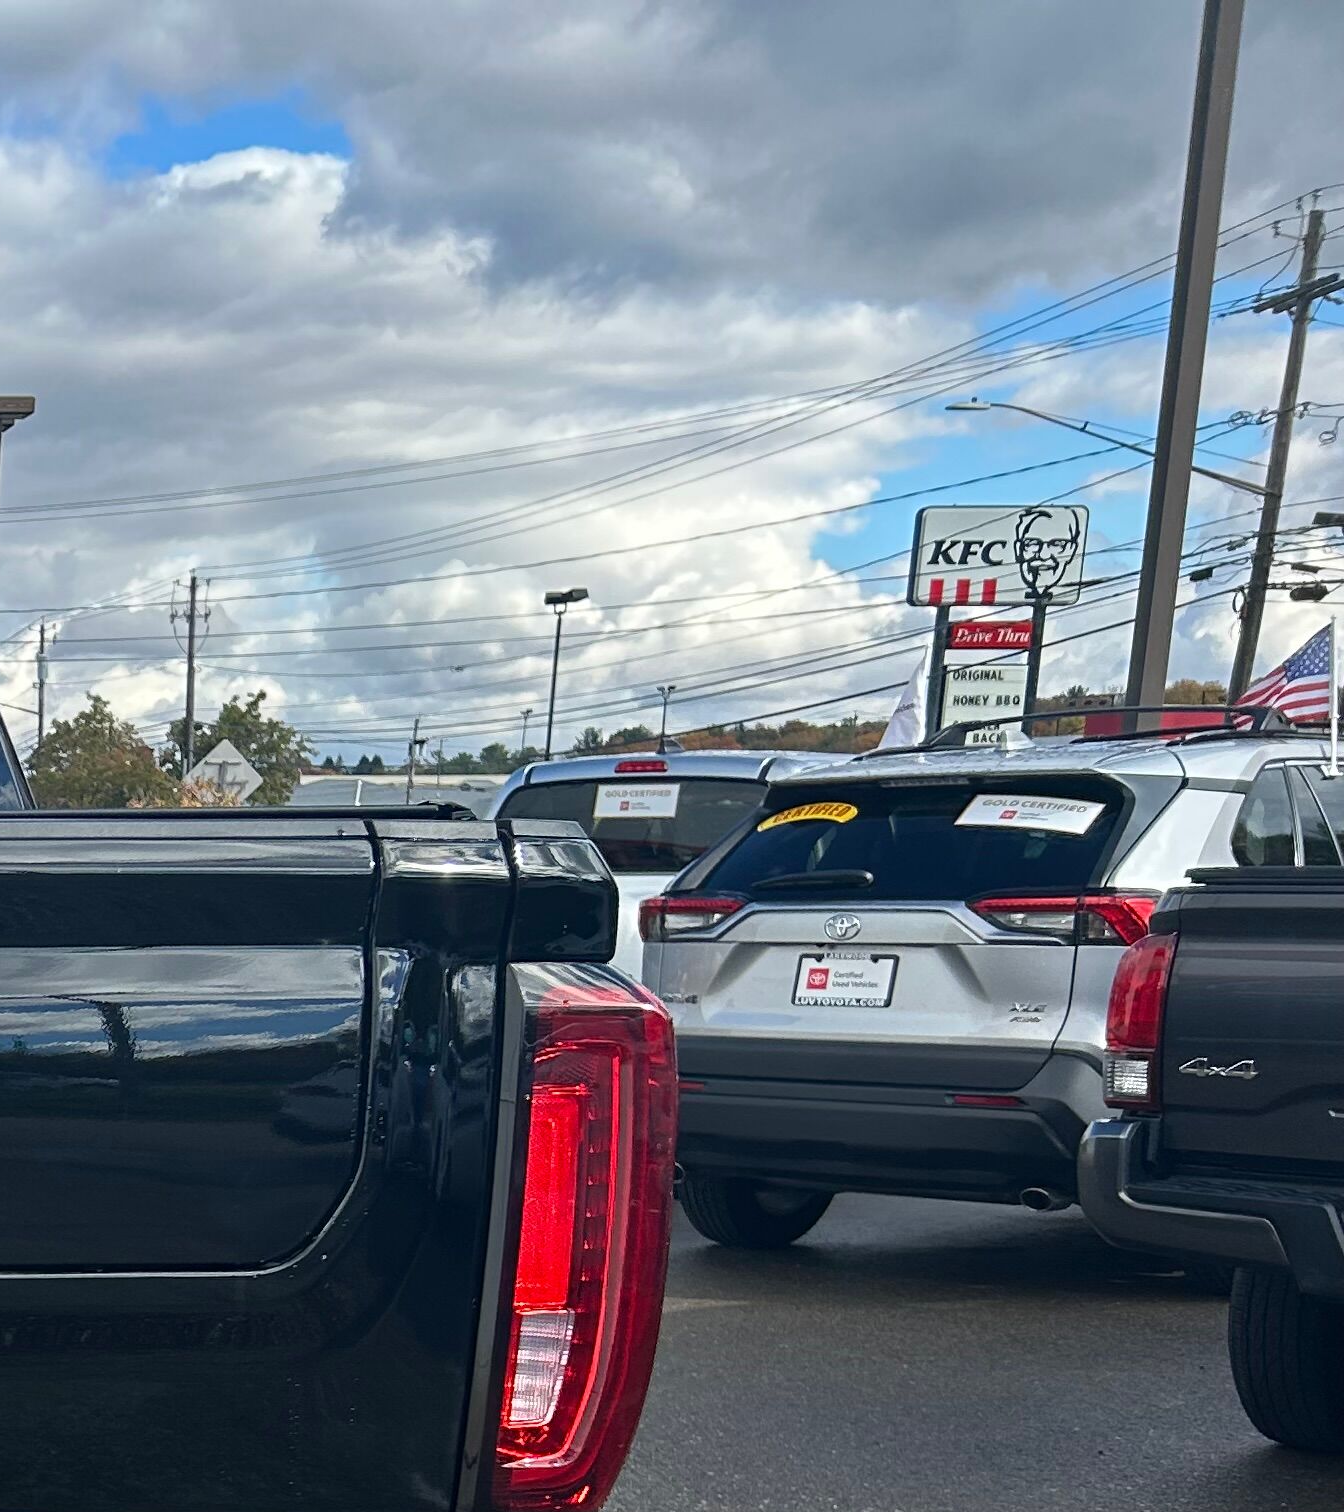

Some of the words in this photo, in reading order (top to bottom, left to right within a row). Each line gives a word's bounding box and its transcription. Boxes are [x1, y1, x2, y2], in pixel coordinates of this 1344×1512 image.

[927, 539, 1008, 566] KFC
[955, 629, 992, 643] Drive
[996, 628, 1031, 643] Thru
[952, 669, 1004, 681] ORIGINAL
[952, 694, 990, 706] HONEY
[995, 694, 1021, 706] BBQ
[982, 799, 1020, 807] GOLD
[1021, 800, 1088, 813] CERTIFIED
[773, 804, 853, 824] CERTIFIED
[833, 971, 864, 979] Certified
[794, 996, 885, 1007] LUVTOYOTA.COM
[1178, 1057, 1259, 1080] 4x4
